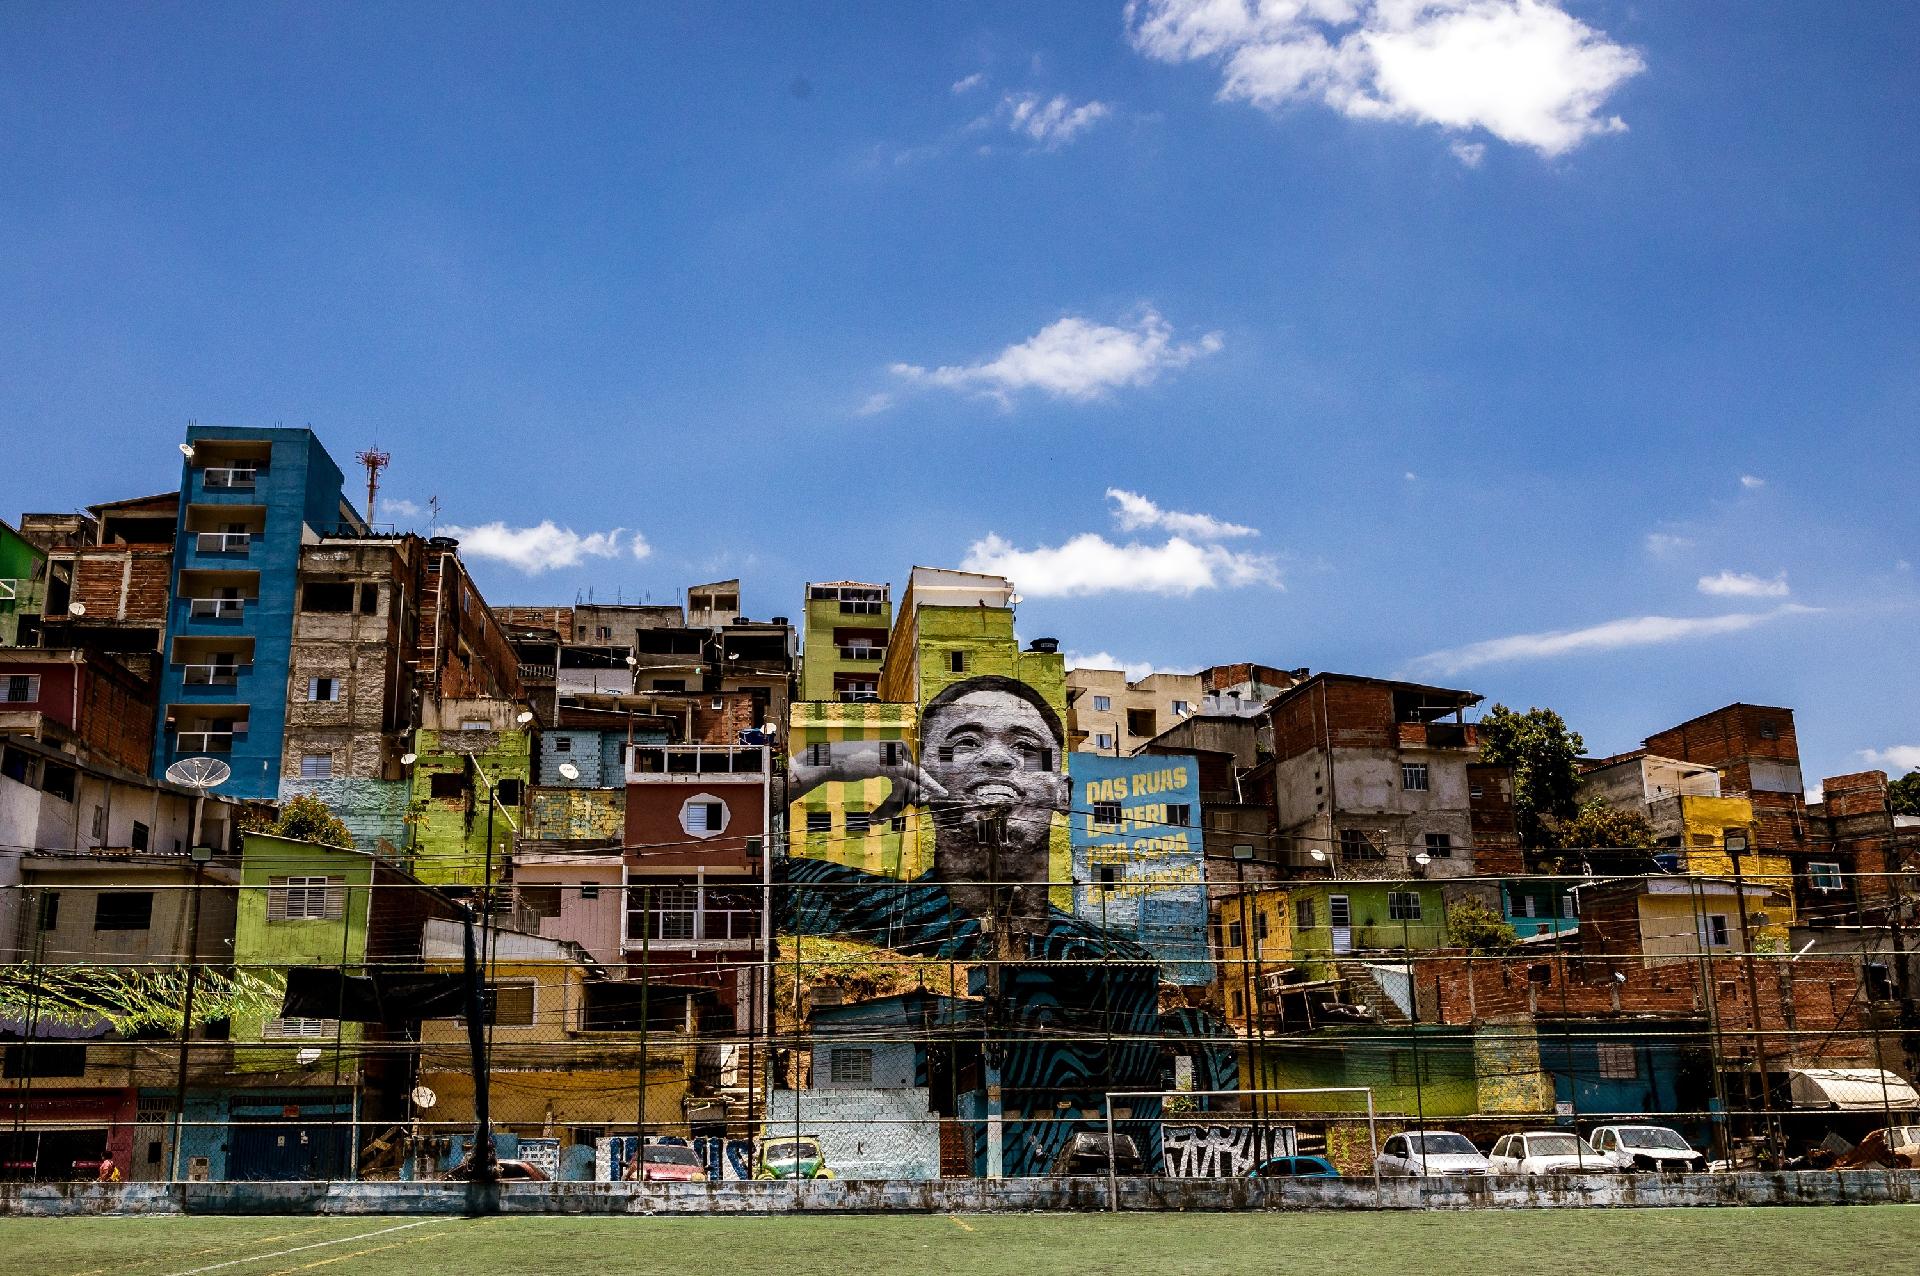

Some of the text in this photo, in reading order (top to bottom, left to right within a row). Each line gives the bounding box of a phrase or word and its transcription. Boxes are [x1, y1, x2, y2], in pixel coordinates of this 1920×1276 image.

[1086, 767, 1188, 805] DAS RUAS
[1121, 804, 1168, 832] PERI
[1134, 832, 1189, 861] COPA
